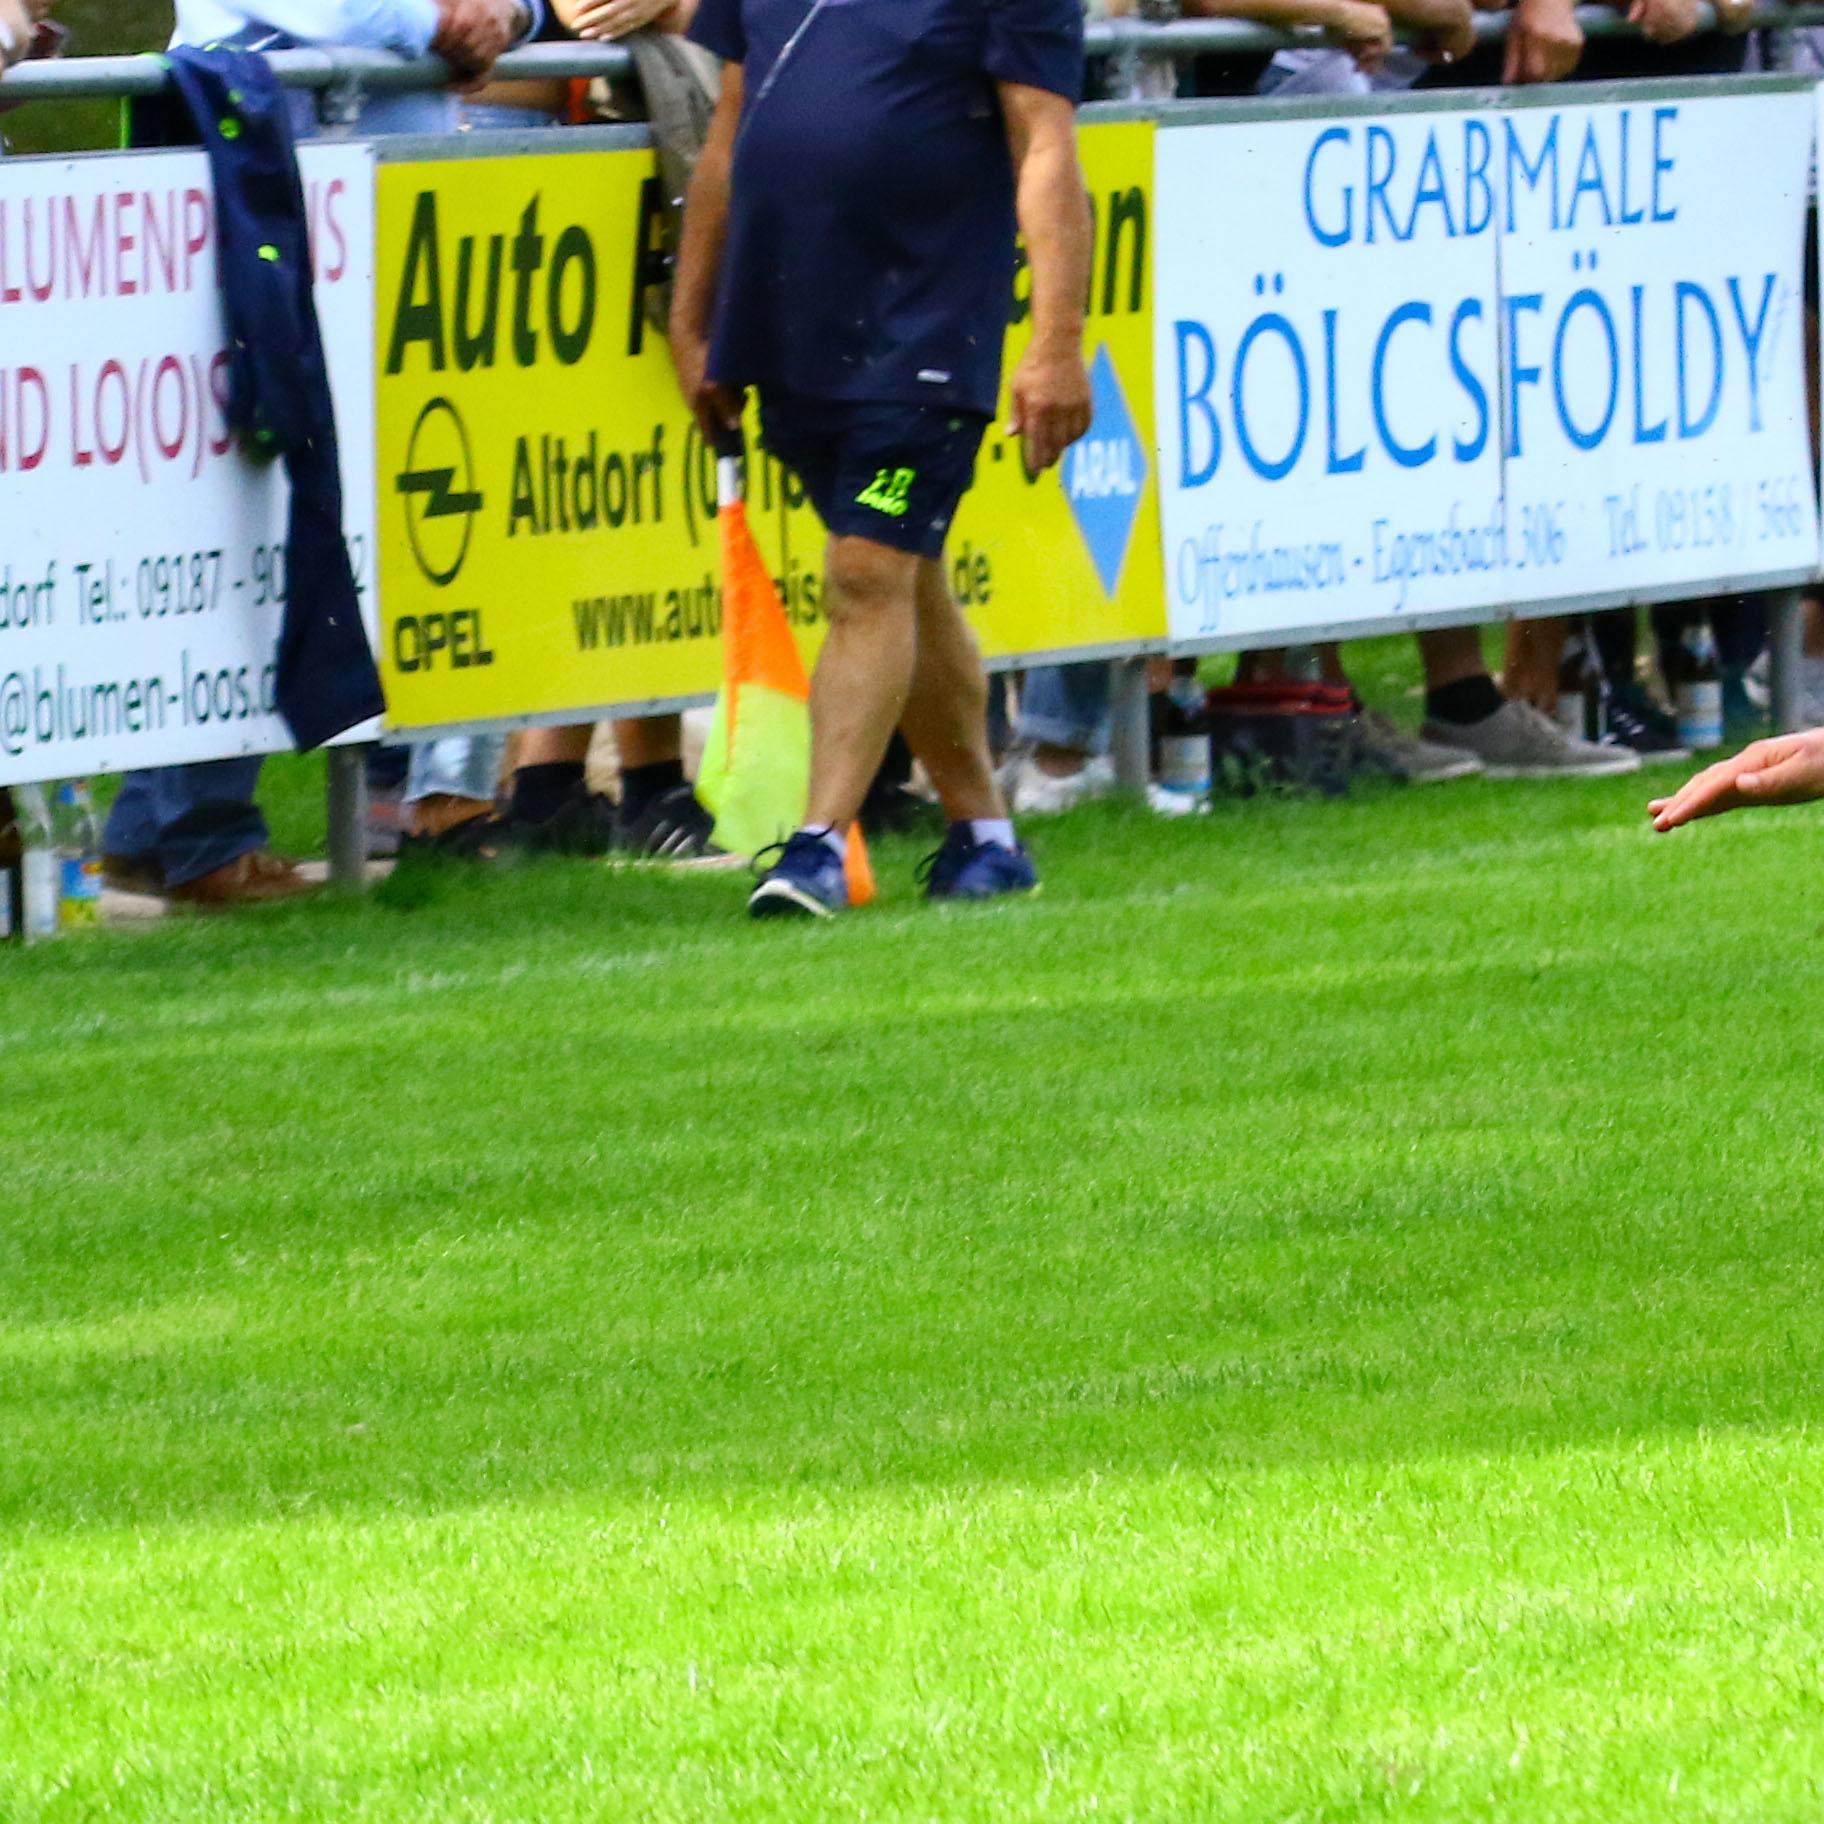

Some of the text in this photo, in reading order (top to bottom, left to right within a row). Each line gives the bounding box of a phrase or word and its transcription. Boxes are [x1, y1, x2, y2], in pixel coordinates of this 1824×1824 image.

[1304, 106, 1679, 248] GRABMALE
[387, 186, 597, 376] Auto
[1172, 249, 1779, 490] BÖLCSFÖLDY
[507, 422, 667, 538] Altdorf
[1072, 437, 1138, 498] ARAL
[137, 547, 224, 619] 09187
[393, 607, 496, 674] OPEL
[0, 646, 280, 757] @blumen-loos.d
